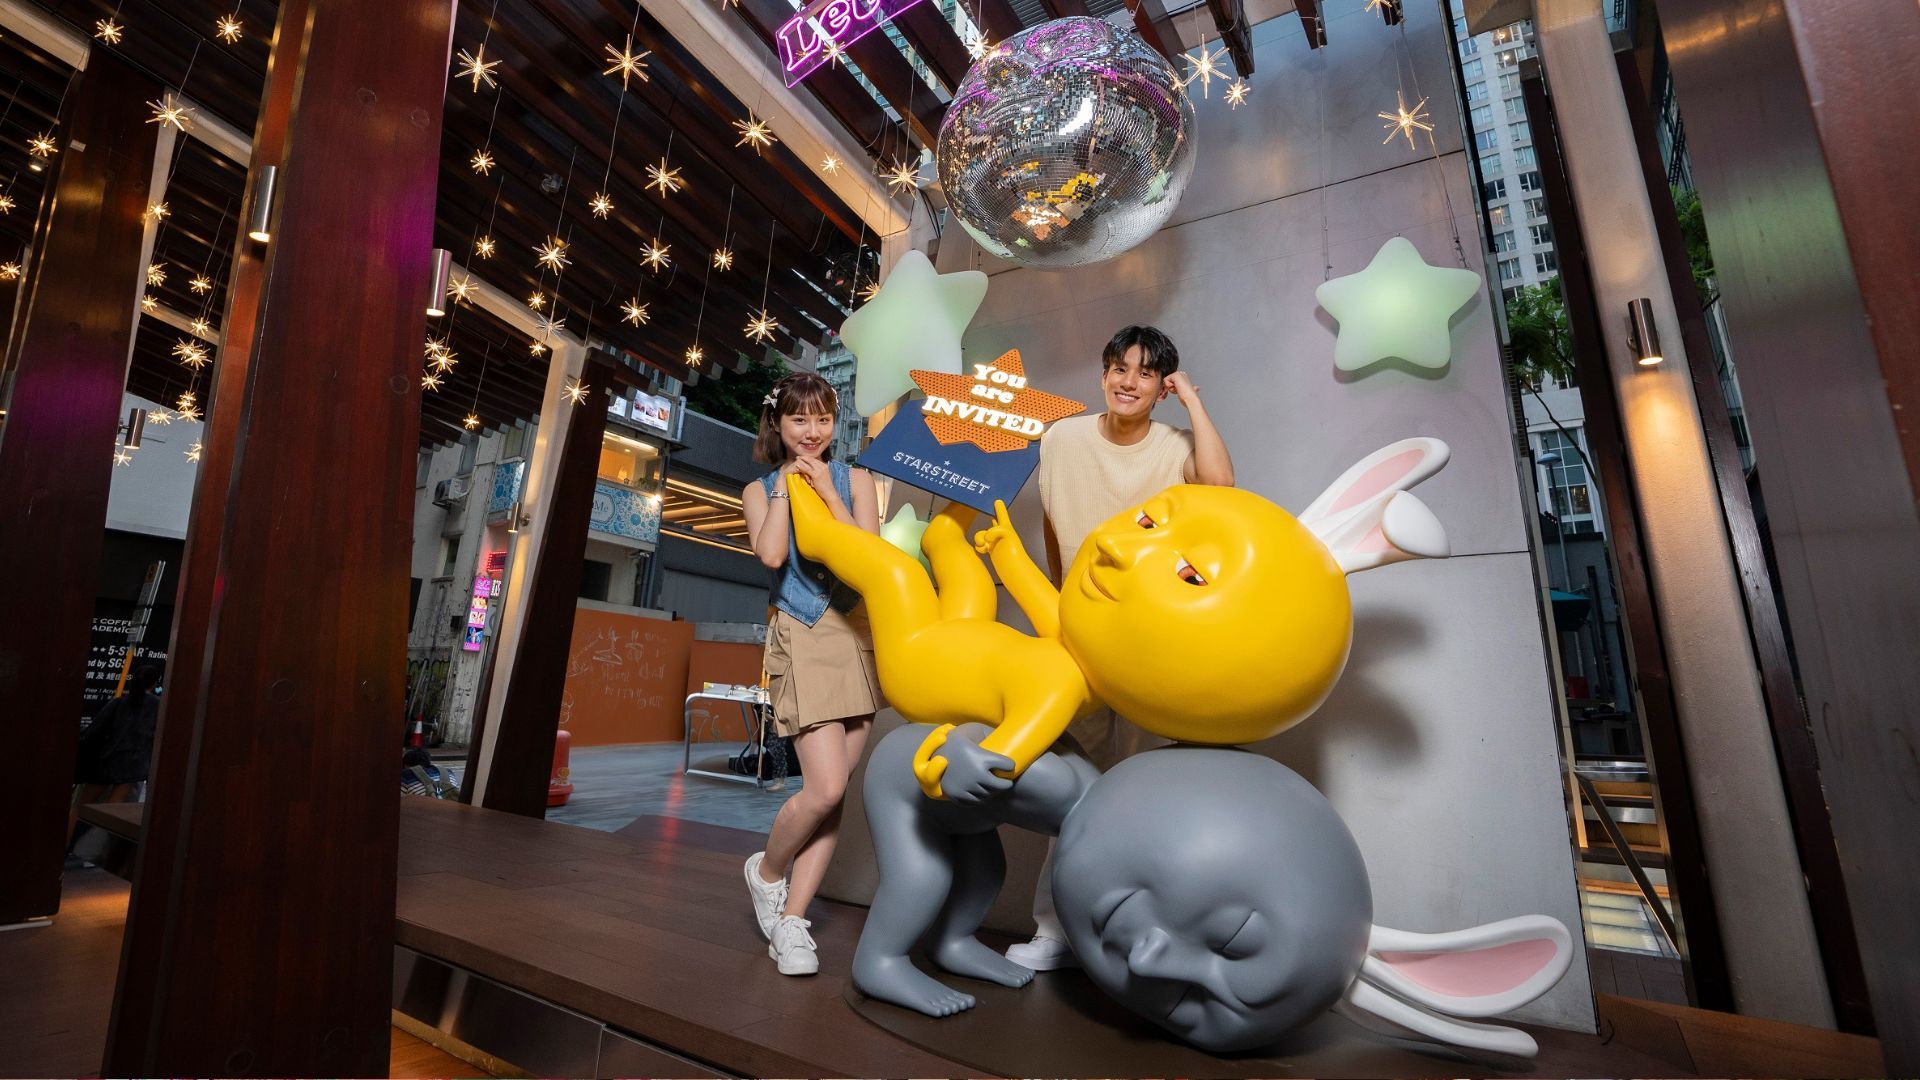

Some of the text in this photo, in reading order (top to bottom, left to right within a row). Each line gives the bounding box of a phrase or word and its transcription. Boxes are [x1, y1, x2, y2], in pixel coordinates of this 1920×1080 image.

[973, 363, 1028, 389] You
[970, 384, 1015, 404] are
[921, 394, 1045, 436] INVITED
[893, 451, 991, 495] STARSTREET
[97, 659, 106, 669] by
